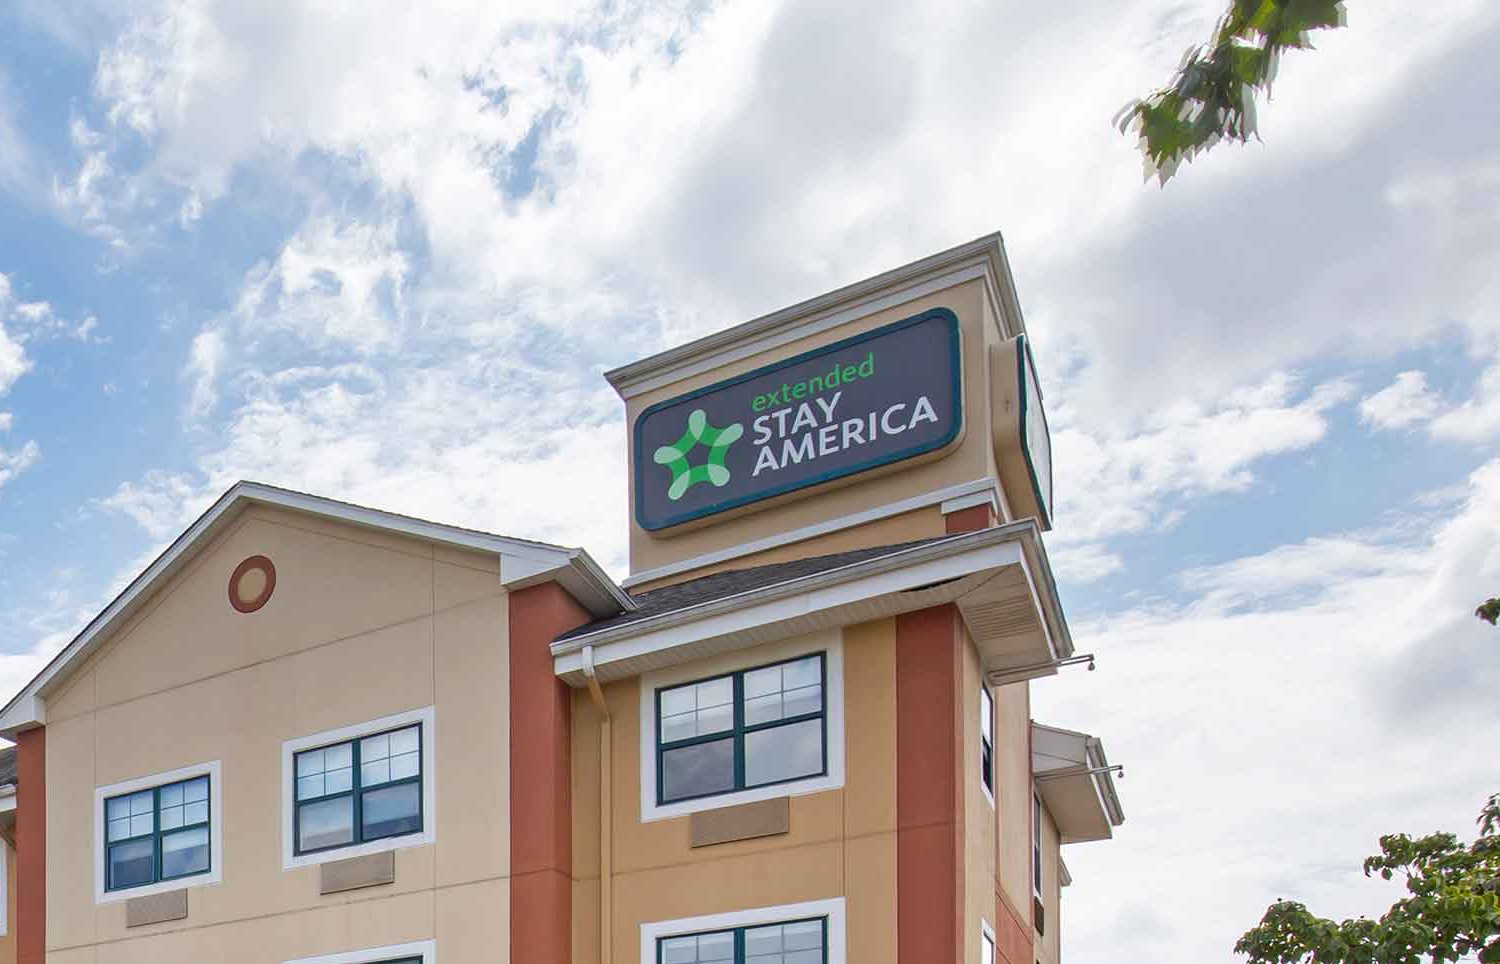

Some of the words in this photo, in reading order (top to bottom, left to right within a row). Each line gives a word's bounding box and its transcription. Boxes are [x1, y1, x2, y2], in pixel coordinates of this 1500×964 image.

[752, 352, 875, 412] extended
[752, 396, 939, 476] AMERICA
[753, 391, 843, 446] STAY
